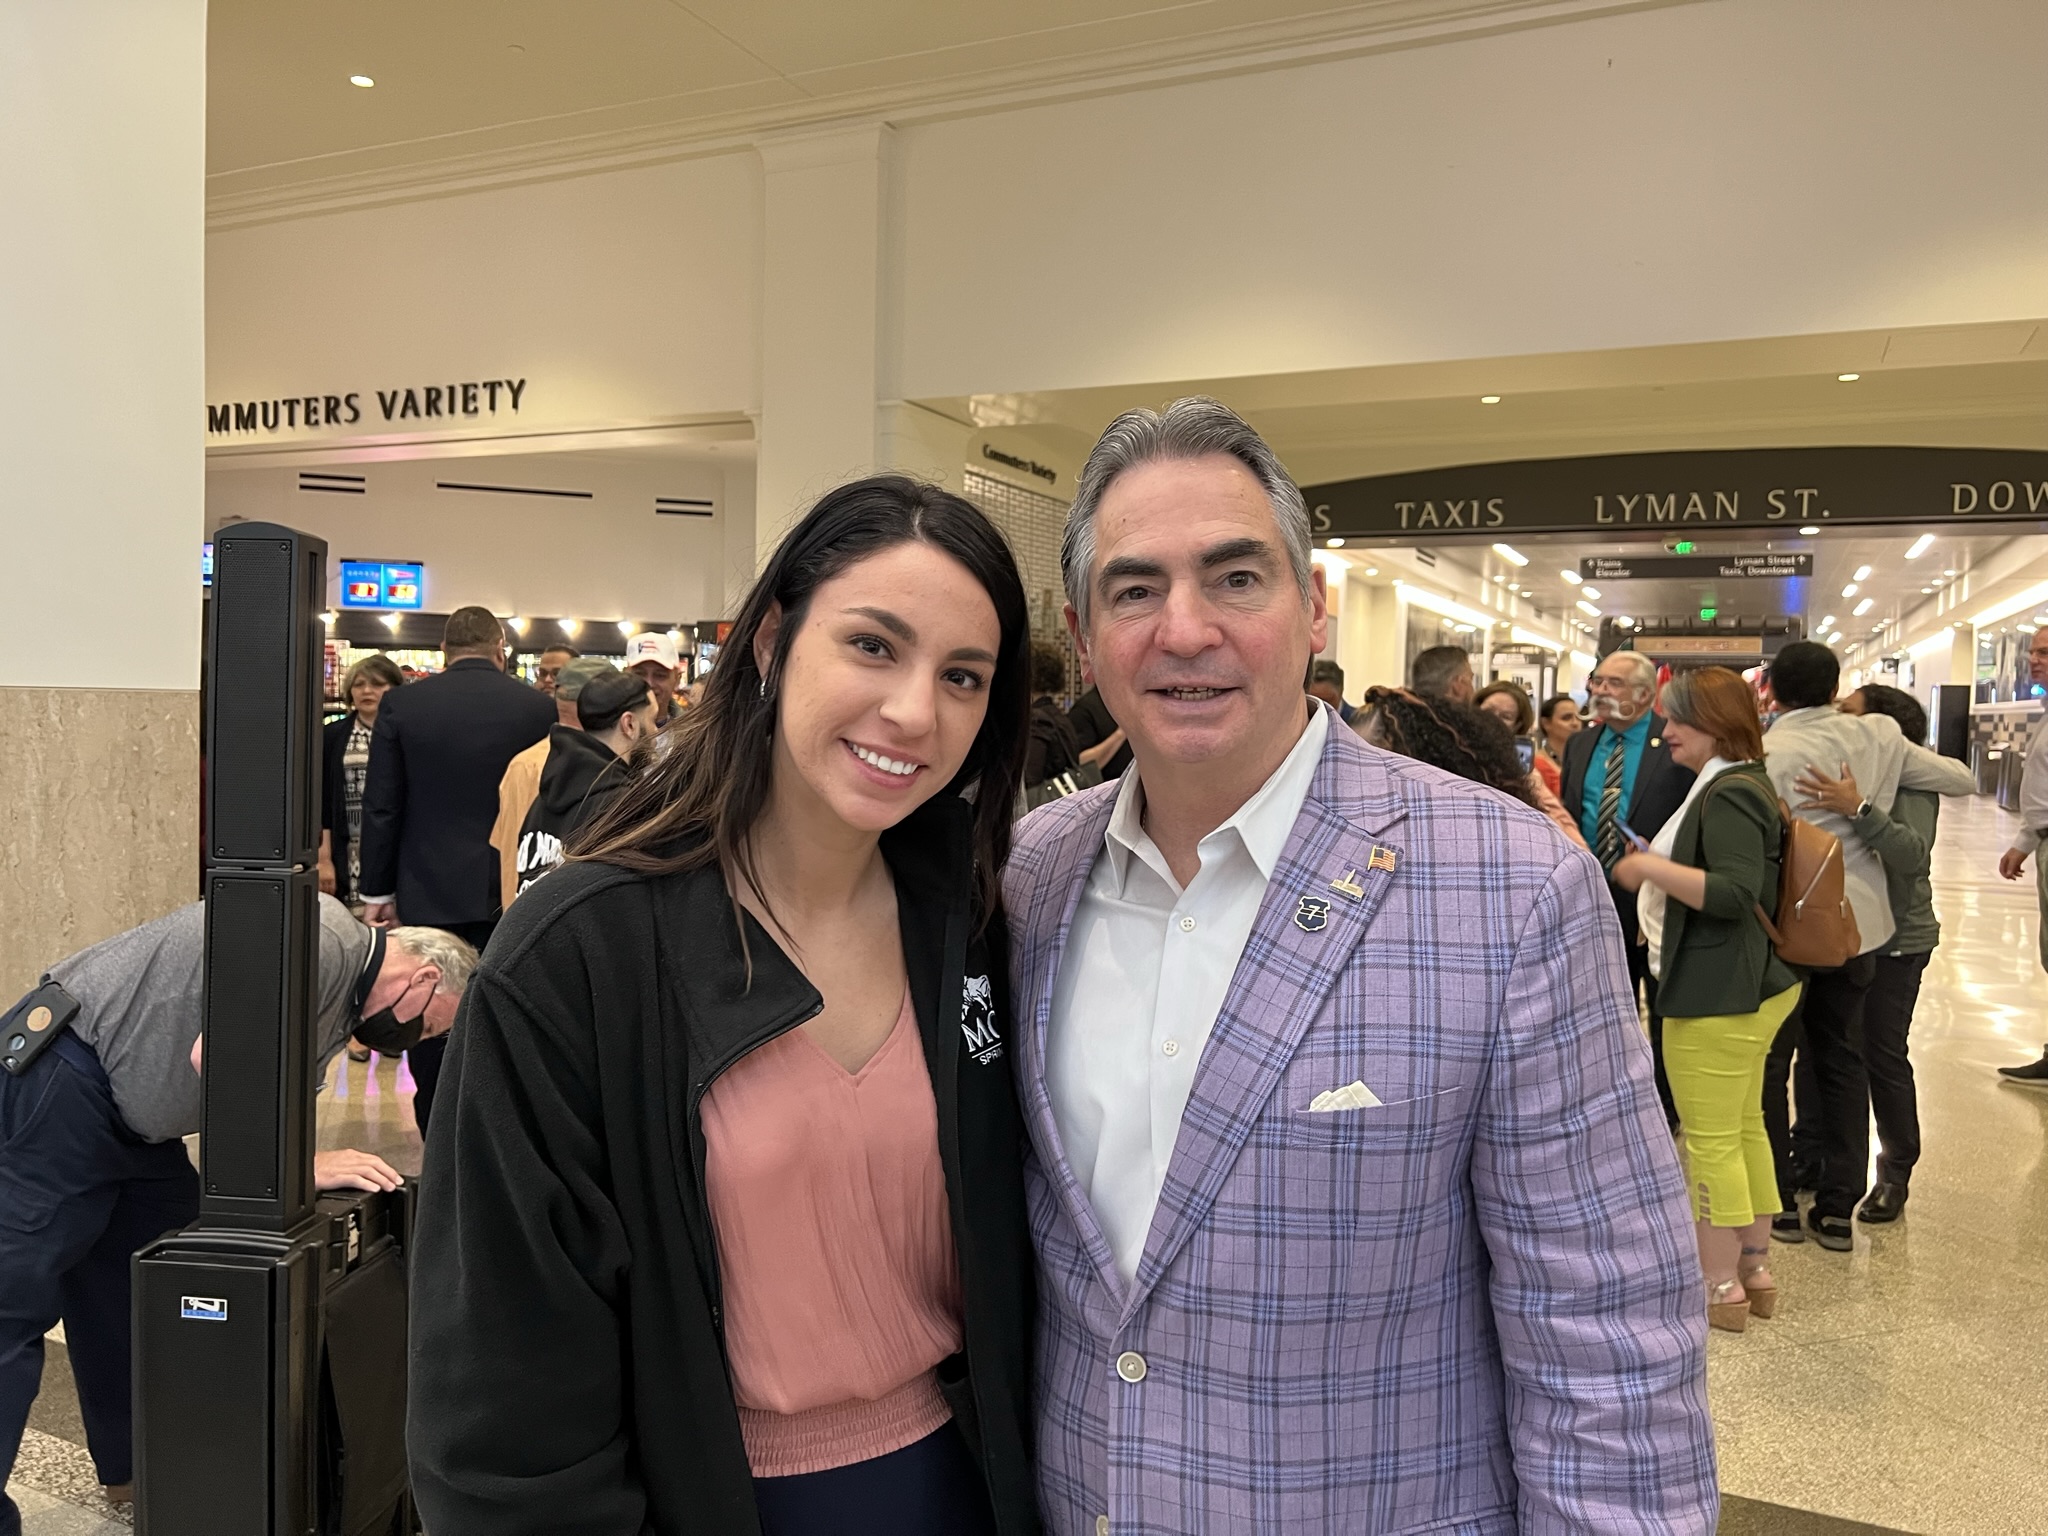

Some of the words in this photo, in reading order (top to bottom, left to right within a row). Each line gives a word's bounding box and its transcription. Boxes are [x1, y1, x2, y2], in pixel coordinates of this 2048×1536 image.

[206, 393, 361, 434] MMUTERS
[376, 378, 526, 421] VARIETY
[1394, 498, 1505, 529] TAXIS
[1594, 490, 1739, 523] LYMAN
[1766, 488, 1831, 519] ST.
[1734, 556, 1765, 567] Lyman
[1767, 555, 1796, 566] Street
[1747, 566, 1795, 576] Downtown
